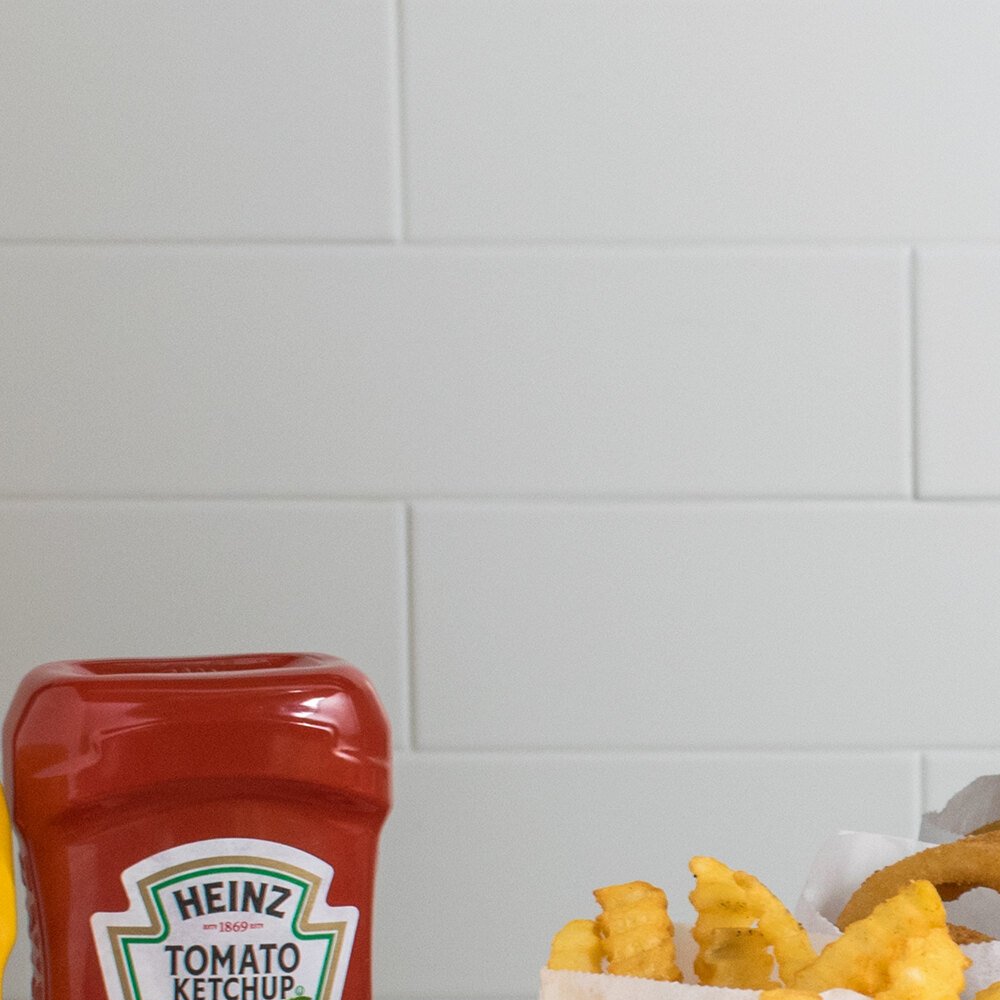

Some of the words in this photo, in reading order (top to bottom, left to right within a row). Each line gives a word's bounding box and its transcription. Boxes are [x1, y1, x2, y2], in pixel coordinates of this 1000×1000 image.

[173, 880, 292, 920] HEINZ
[219, 921, 249, 932] 1869
[165, 943, 300, 976] TOMATO
